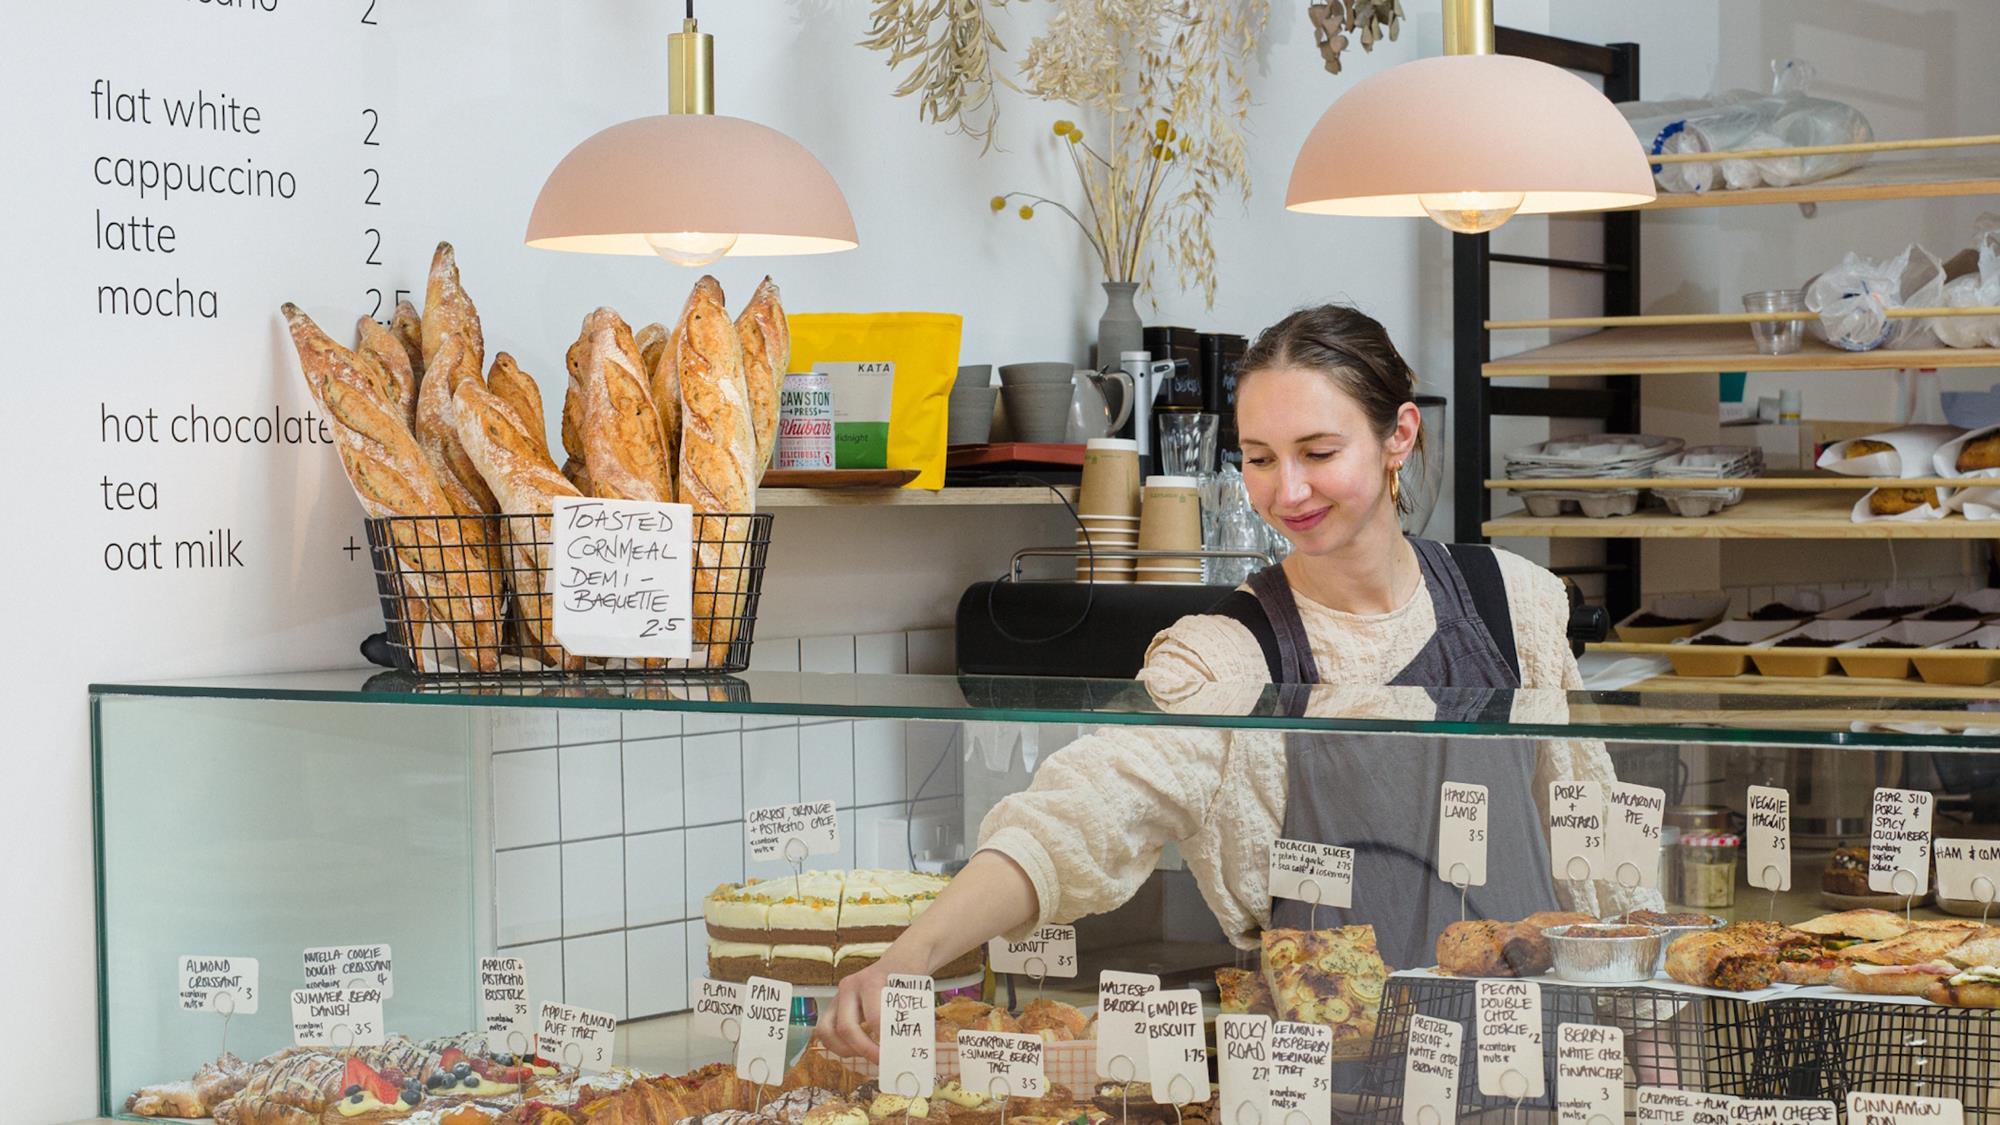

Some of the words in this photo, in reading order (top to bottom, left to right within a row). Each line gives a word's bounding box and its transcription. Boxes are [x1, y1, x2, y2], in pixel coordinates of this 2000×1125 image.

[361, 0, 377, 25] 2
[91, 79, 151, 124] flat
[163, 90, 261, 134] white
[362, 108, 380, 146] 2
[94, 156, 296, 200] cappuccino
[363, 168, 381, 205] 2
[96, 208, 176, 253] latte
[364, 228, 382, 265] 2
[98, 278, 218, 318] mocha
[858, 363, 890, 373] KATA
[781, 391, 830, 406] CAWSTON
[794, 407, 818, 416] PRESS
[101, 402, 159, 443] hot
[171, 404, 334, 444] chocolate
[780, 418, 832, 436] Rhubarb
[100, 475, 158, 511] tea
[563, 502, 673, 532] TOASTED
[104, 534, 163, 571] oat
[175, 528, 244, 569] milk
[567, 534, 677, 567] CORNMEAL
[564, 589, 669, 614] BAGUETTE
[640, 618, 685, 638] 2.5
[1444, 787, 1486, 805] HARISSA
[1554, 784, 1587, 801] PORK
[1875, 792, 1903, 803] CHAR
[1909, 793, 1927, 805] SIU
[1611, 791, 1661, 811] MACARONI
[1750, 795, 1787, 813] VEGGIE
[792, 803, 831, 816] ORANGE
[1444, 805, 1477, 821] LAMB
[1625, 809, 1643, 825] PIE
[1875, 804, 1902, 815] PORK
[760, 821, 804, 835] PISTACHIO
[1550, 814, 1599, 830] MUSTARD
[1752, 812, 1787, 831] HAGGIS
[1875, 817, 1905, 830] SPICY
[1642, 823, 1659, 839] 4.5
[1274, 840, 1317, 855] FOCACCIA
[1585, 836, 1600, 848] 3.5
[1936, 847, 1962, 860] HAM
[1041, 928, 1074, 940] LECHE
[304, 950, 343, 963] NUTELLA
[347, 947, 382, 960] COOKIE
[187, 960, 230, 973] ALMOND
[306, 964, 336, 977] DOUGH
[343, 960, 391, 974] CROISSANT
[482, 959, 516, 971] APRICOT
[377, 973, 388, 986] 4
[482, 972, 524, 986] PISTACHIO
[246, 987, 253, 1000] 3
[293, 990, 344, 1004] SUMMER
[349, 989, 381, 1003] BERRY
[703, 983, 736, 998] PLAIN
[752, 984, 780, 1001] PAIN
[1481, 983, 1527, 995] PECAN
[697, 999, 743, 1016] CROISSAN
[887, 992, 928, 1010] PASTEL
[1103, 998, 1145, 1013] BROOKI
[1148, 1000, 1198, 1018] EMPIRE
[1481, 998, 1532, 1010] DOUBLE
[311, 1004, 350, 1017] DANISH
[747, 1005, 786, 1022] SUISSE
[896, 1010, 908, 1022] DE
[1484, 1009, 1518, 1022] CHOC
[545, 1020, 566, 1036] PUFF
[571, 1026, 598, 1040] TART
[580, 1012, 615, 1032] ALMOND
[891, 1023, 921, 1037] NATA
[768, 1026, 784, 1040] 3.5
[1149, 1023, 1196, 1039] BISCUIT
[1224, 1020, 1267, 1041] ROCKY
[1274, 1024, 1315, 1037] LEMON
[1534, 1033, 1541, 1044] 2
[1564, 1027, 1605, 1043] BERRY
[958, 1035, 1015, 1050] MASCARPONE
[1017, 1040, 1041, 1052] CREAM
[1272, 1037, 1330, 1054] RASPBERRY
[1411, 1031, 1442, 1048] BISCOFF
[596, 1048, 602, 1061] 3
[1010, 1052, 1039, 1066] BERRY
[1185, 1049, 1205, 1062] 1.75
[1228, 1041, 1266, 1061] ROAD
[1272, 1051, 1327, 1065] MERINGUE
[1409, 1046, 1437, 1060] WHITE
[1559, 1047, 1594, 1061] WHITE
[987, 1062, 1011, 1074] TART
[1274, 1065, 1306, 1077] TART
[1412, 1060, 1454, 1079] BROWNIE
[1559, 1063, 1623, 1081] FINANCIER
[1022, 1078, 1036, 1089] 3.5
[1445, 1087, 1452, 1099] 3
[1601, 1087, 1610, 1101] 3
[1639, 1092, 1693, 1107] CARAMEL
[1730, 1104, 1777, 1122] CREAM
[1782, 1105, 1833, 1121] CHEESE
[1854, 1097, 1941, 1116] CINNAMON
[1638, 1107, 1684, 1122] BRITTLE
[1693, 1111, 1729, 1125] BROWN
